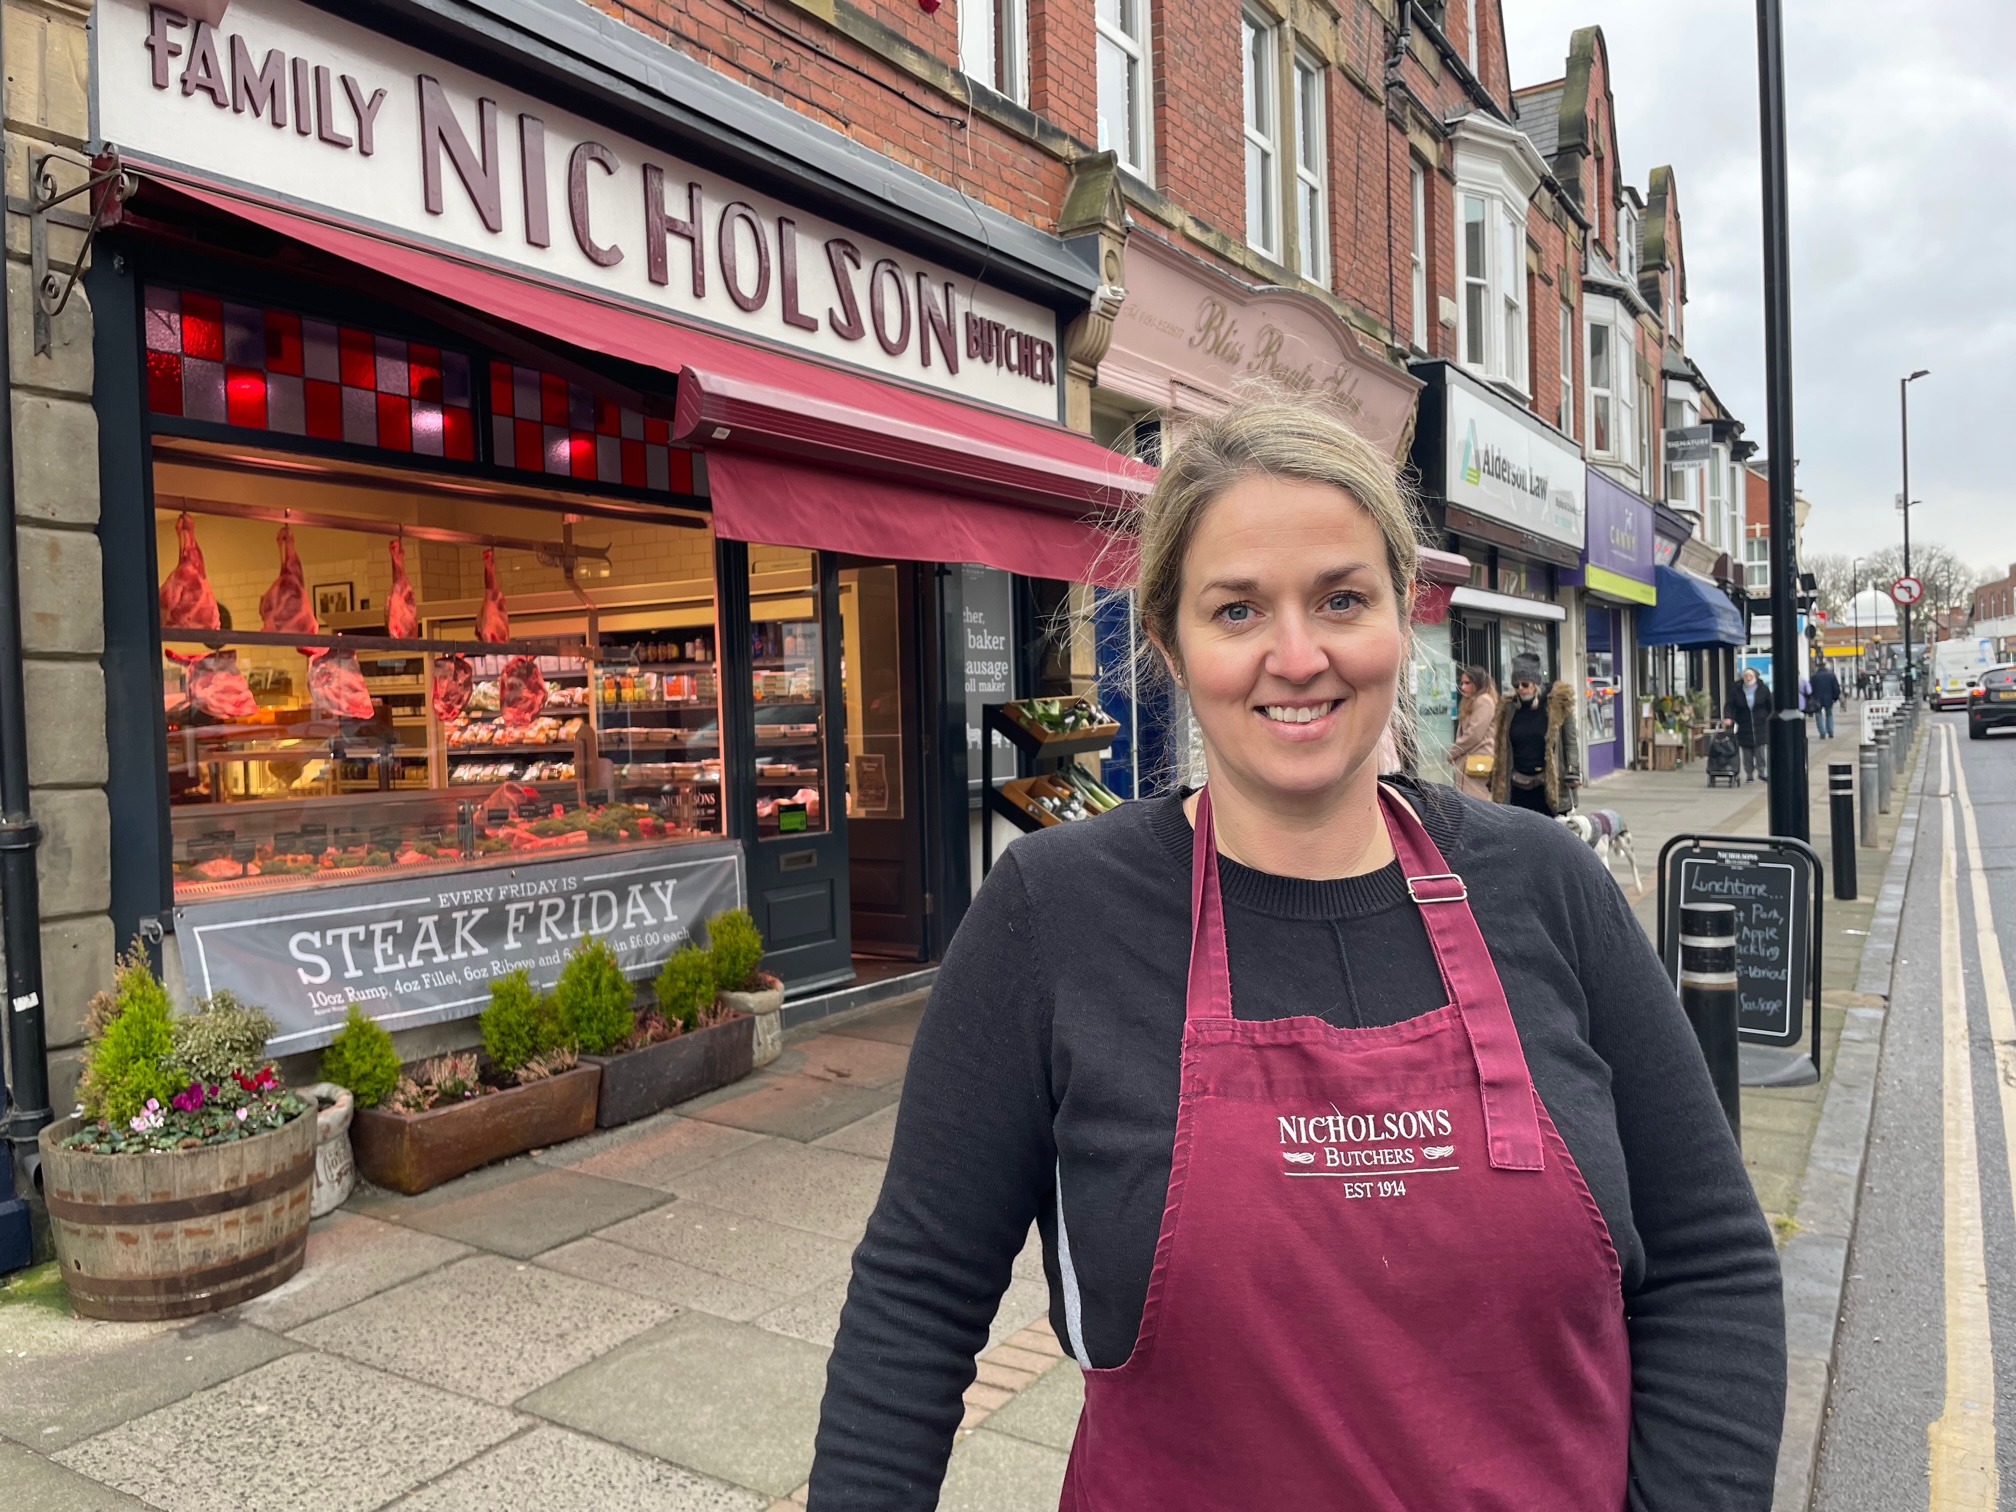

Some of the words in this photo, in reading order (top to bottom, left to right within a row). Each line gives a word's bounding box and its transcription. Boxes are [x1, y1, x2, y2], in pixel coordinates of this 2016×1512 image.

[144, 3, 388, 156] FAMILY
[418, 73, 958, 374] NICHOLSON
[965, 311, 1055, 386] BUTCHER
[1188, 295, 1246, 366] Bliss
[1667, 438, 1709, 448] SIGNATURE
[1482, 443, 1528, 492] Alderson
[1529, 466, 1549, 501] Law
[967, 628, 1005, 650] baker
[965, 660, 1008, 681] ausage
[965, 678, 976, 692] oll
[978, 679, 1005, 692] maker
[439, 887, 494, 909] EVERY
[498, 880, 558, 902] FRIDAY
[561, 877, 578, 891] IS
[288, 907, 490, 985] STEAK
[503, 879, 679, 951] FRIDAY
[1742, 925, 1779, 945] Apple
[307, 991, 345, 1008] 10oz
[343, 984, 393, 1003] Rump,
[394, 979, 421, 995] 4oz
[420, 968, 462, 989] Fillet,
[463, 966, 489, 981] 6oz
[538, 949, 561, 966] and
[629, 932, 660, 949] £6.00
[662, 926, 690, 943] each
[1277, 1108, 1452, 1144] NICHOLSONS
[1324, 1147, 1415, 1167] BUTCHERS
[1343, 1182, 1374, 1199] EST
[1377, 1180, 1406, 1197] 1914
